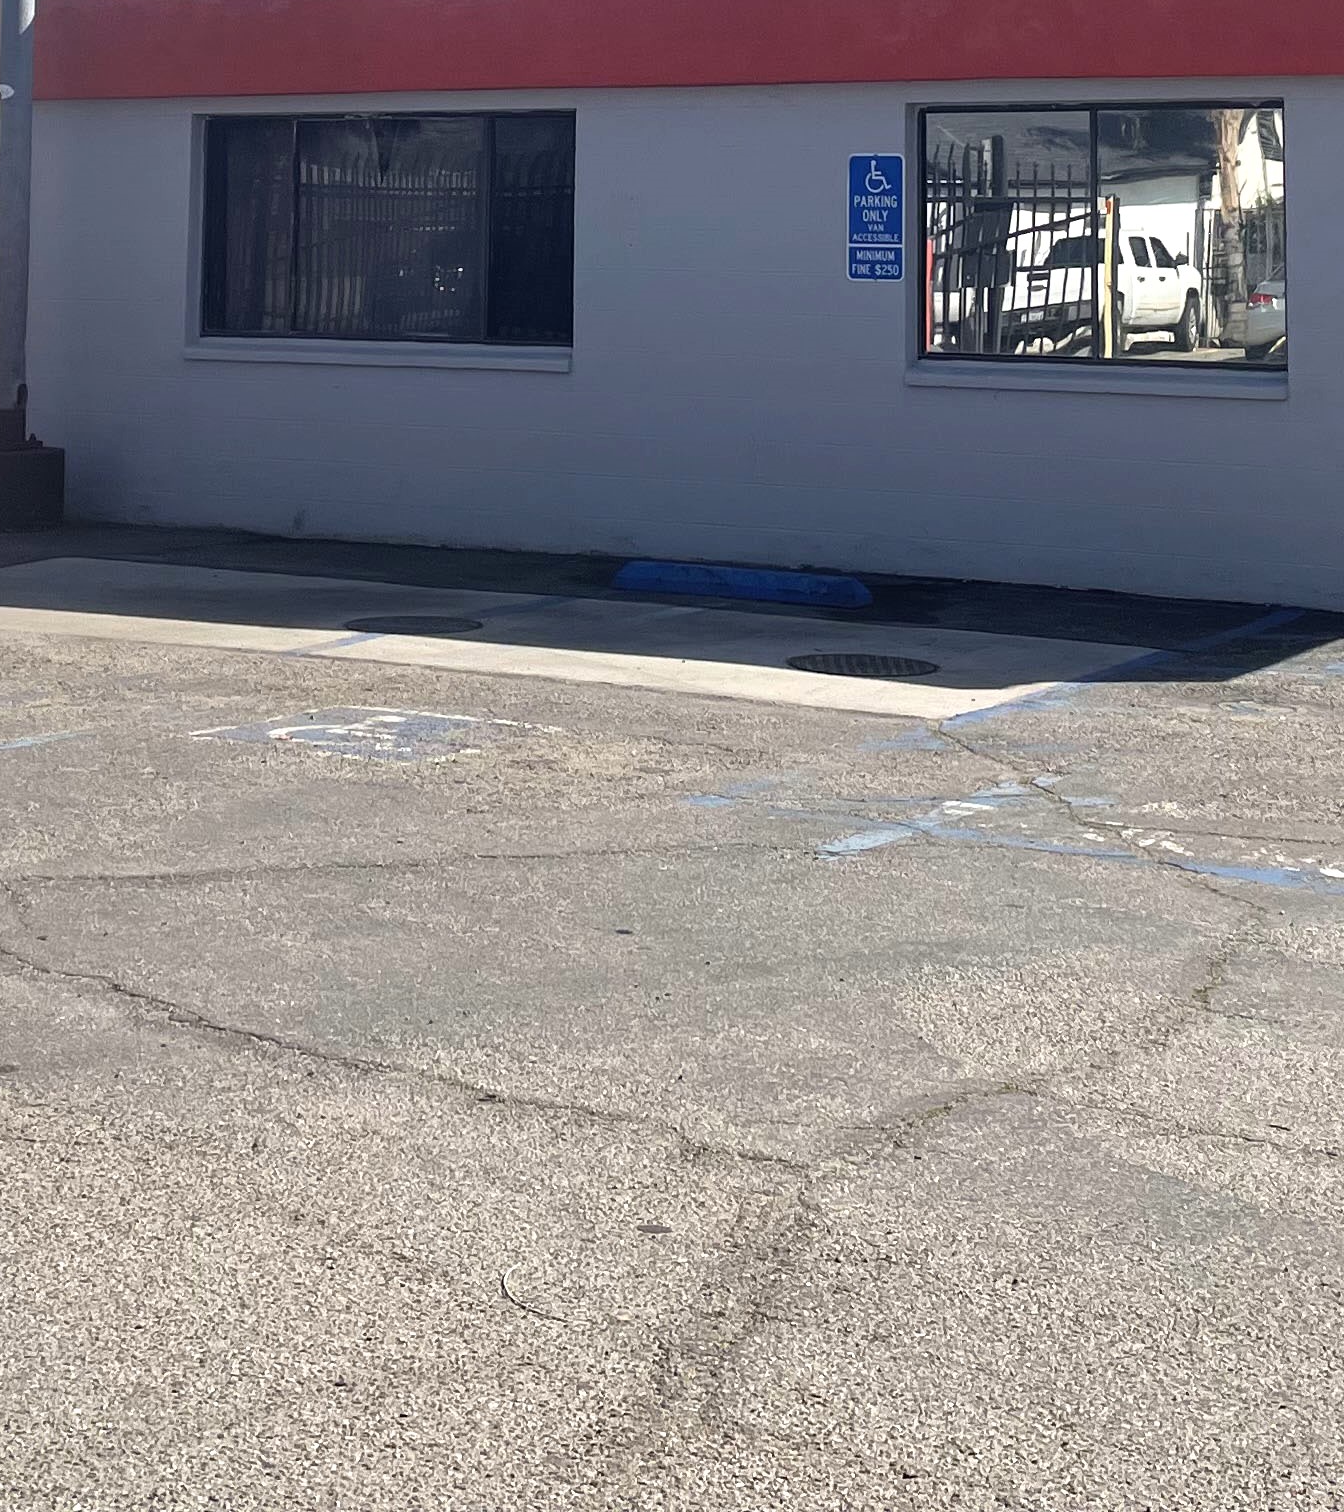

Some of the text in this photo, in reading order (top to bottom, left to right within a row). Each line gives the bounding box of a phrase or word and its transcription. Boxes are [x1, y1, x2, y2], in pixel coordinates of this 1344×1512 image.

[854, 195, 897, 208] PARKING
[863, 209, 889, 222] ONLY
[852, 234, 899, 242] ACCESSIBLE
[856, 250, 895, 261] MINIMUM
[852, 264, 899, 276] FINE $250
